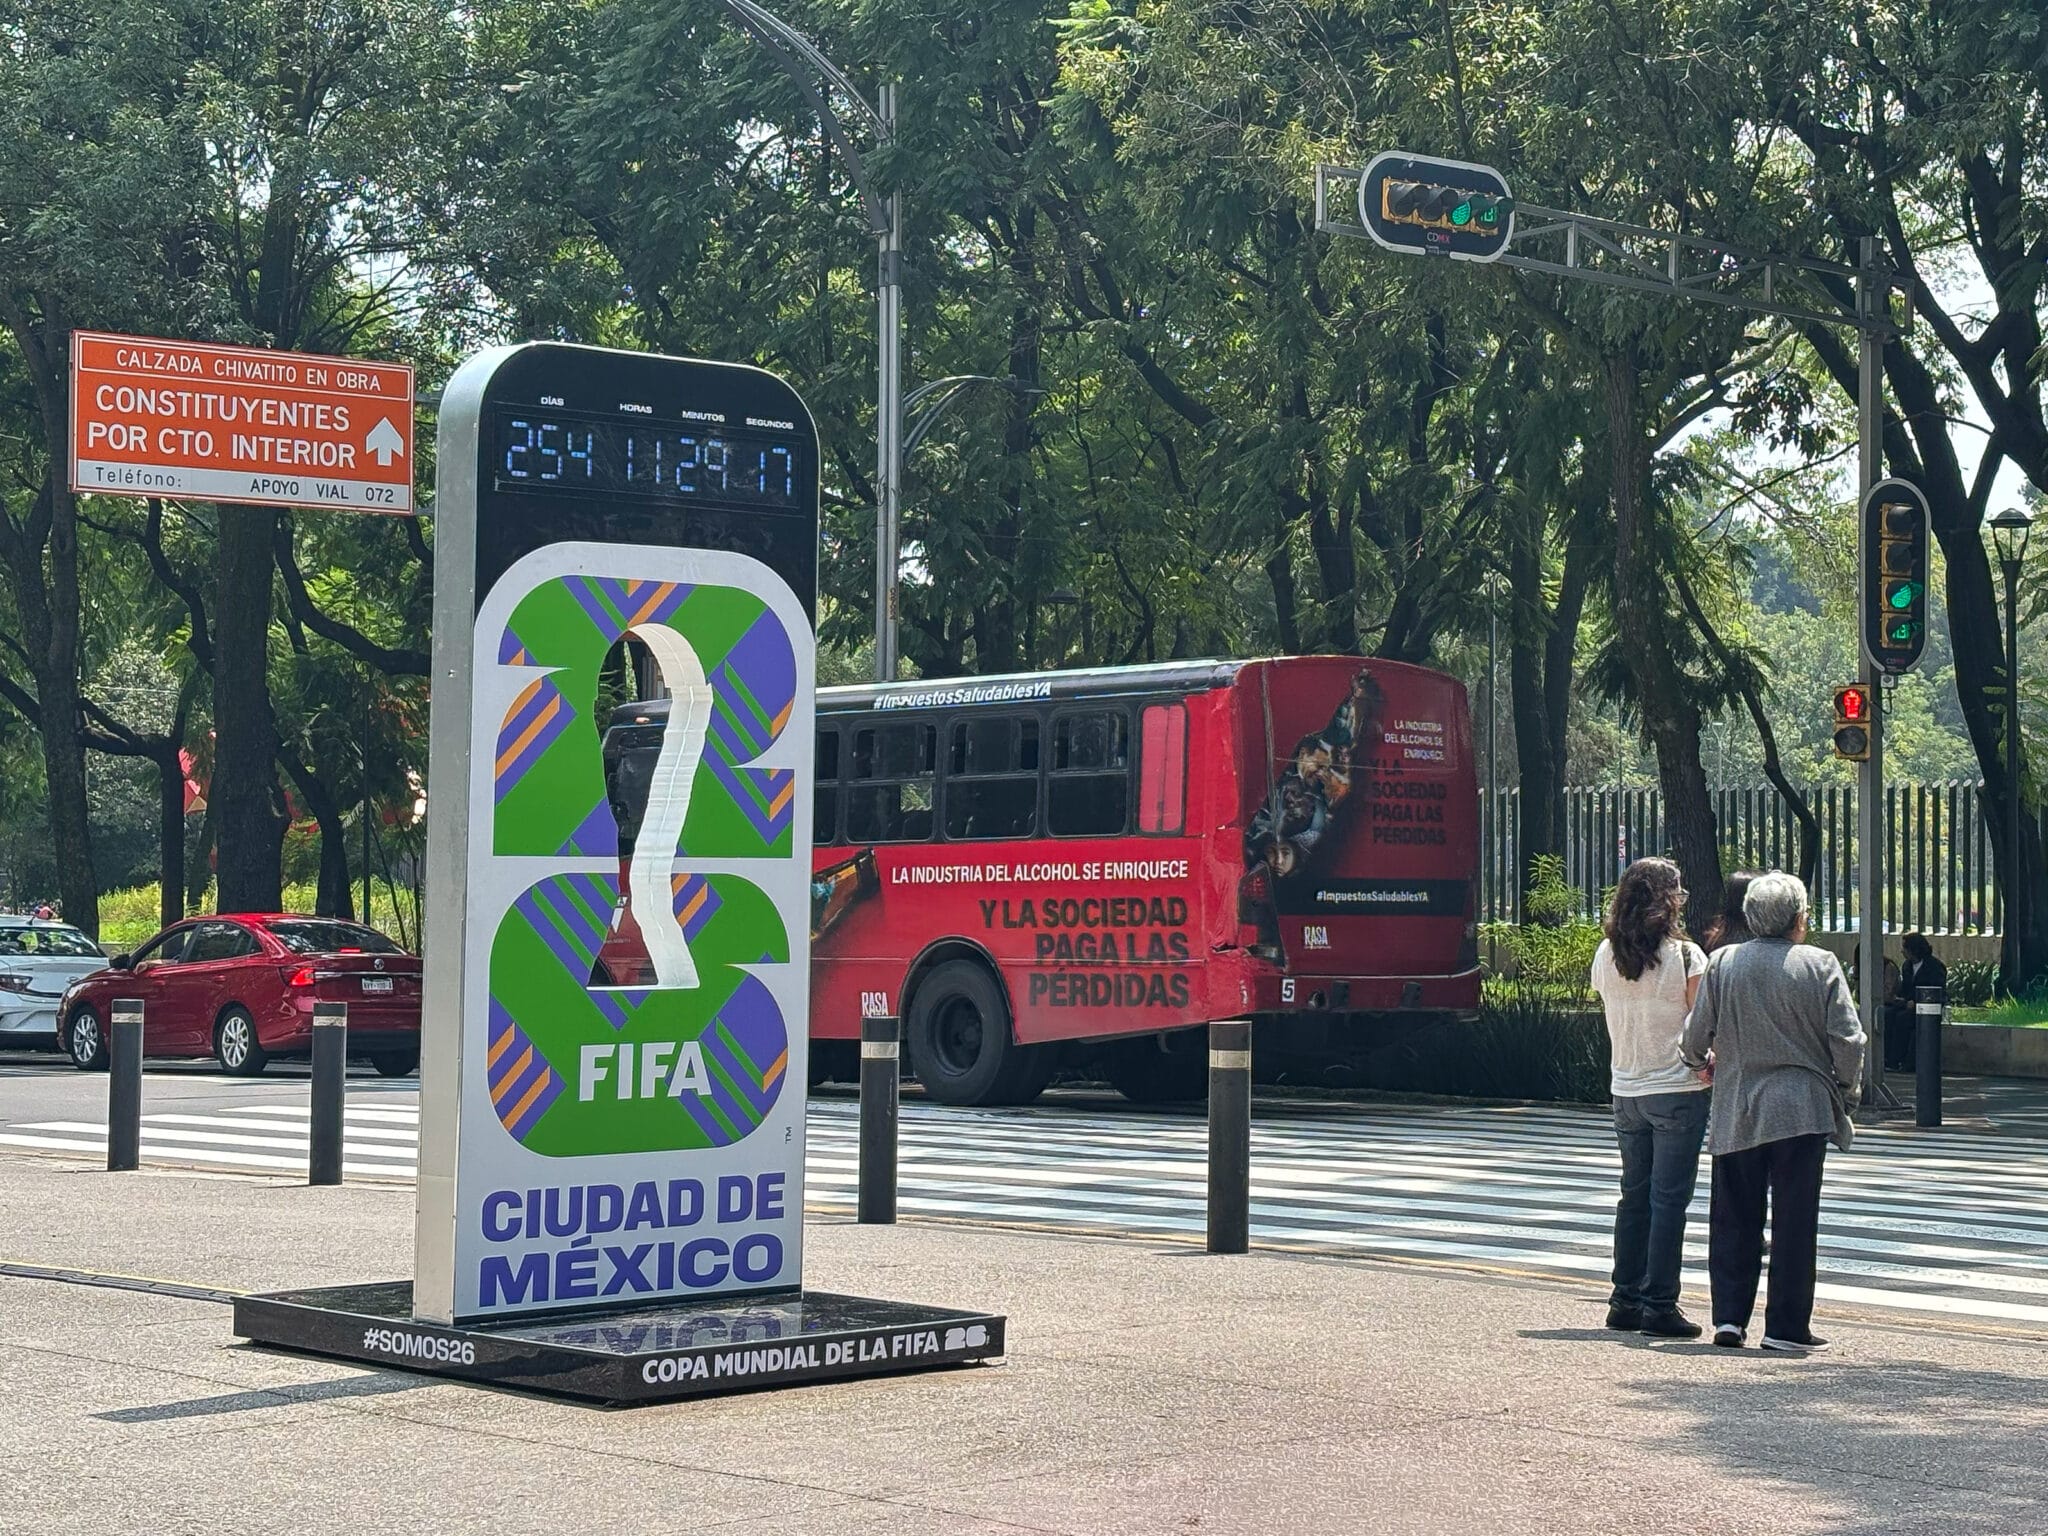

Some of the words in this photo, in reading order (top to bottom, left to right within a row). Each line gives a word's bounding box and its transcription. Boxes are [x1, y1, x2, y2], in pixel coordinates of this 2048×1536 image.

[116, 348, 203, 374] CALZADA
[214, 360, 297, 384] CHIVATITO
[306, 368, 328, 387] EN
[336, 371, 381, 392] OBRA
[95, 384, 350, 432] CONSTITUYENTES
[540, 396, 564, 407] DÍAS
[619, 403, 653, 414] HORAS
[681, 410, 725, 423] MINUTOS
[745, 417, 794, 430] SEGUNDOS
[87, 422, 147, 453] POR
[158, 428, 220, 458] CTO.
[231, 433, 356, 469] INTERIOR
[507, 421, 593, 480] 254
[627, 437, 661, 484] 11
[676, 437, 728, 492] 29
[759, 447, 792, 496] 17
[95, 466, 182, 488] Teléfono:
[249, 478, 300, 496] APOYO
[315, 483, 349, 500] VIAL
[365, 486, 395, 503] 072
[892, 867, 909, 884] LA
[911, 864, 983, 884] INDUSTRIA
[985, 864, 1012, 882] DEL
[1013, 862, 1081, 882] ALCOHOL
[1083, 862, 1100, 881] SE
[1104, 860, 1188, 881] ENRIQUECE
[979, 899, 997, 929] Y
[1002, 898, 1038, 929] LA
[1042, 896, 1189, 928] SOCIEDAD
[1316, 890, 1429, 904] #ImpuestosSaludablesYA
[1034, 932, 1121, 967] PAGA
[1126, 932, 1189, 968] LAS
[1304, 926, 1328, 948] RASA
[861, 991, 889, 1018] RASA
[1028, 968, 1189, 1008] PÉRDIDAS
[1283, 982, 1294, 999] 5
[579, 1040, 713, 1102] FIFA
[480, 1178, 705, 1243] CIUDAD
[717, 1171, 786, 1224] DE
[478, 1233, 784, 1308] MÉXICO
[363, 1327, 476, 1366] #SOMOS26
[642, 1354, 710, 1384] COPA
[713, 1346, 820, 1378] MUNDIAL
[824, 1341, 854, 1364] DE
[858, 1338, 887, 1362] LA
[892, 1330, 940, 1358] FIFA
